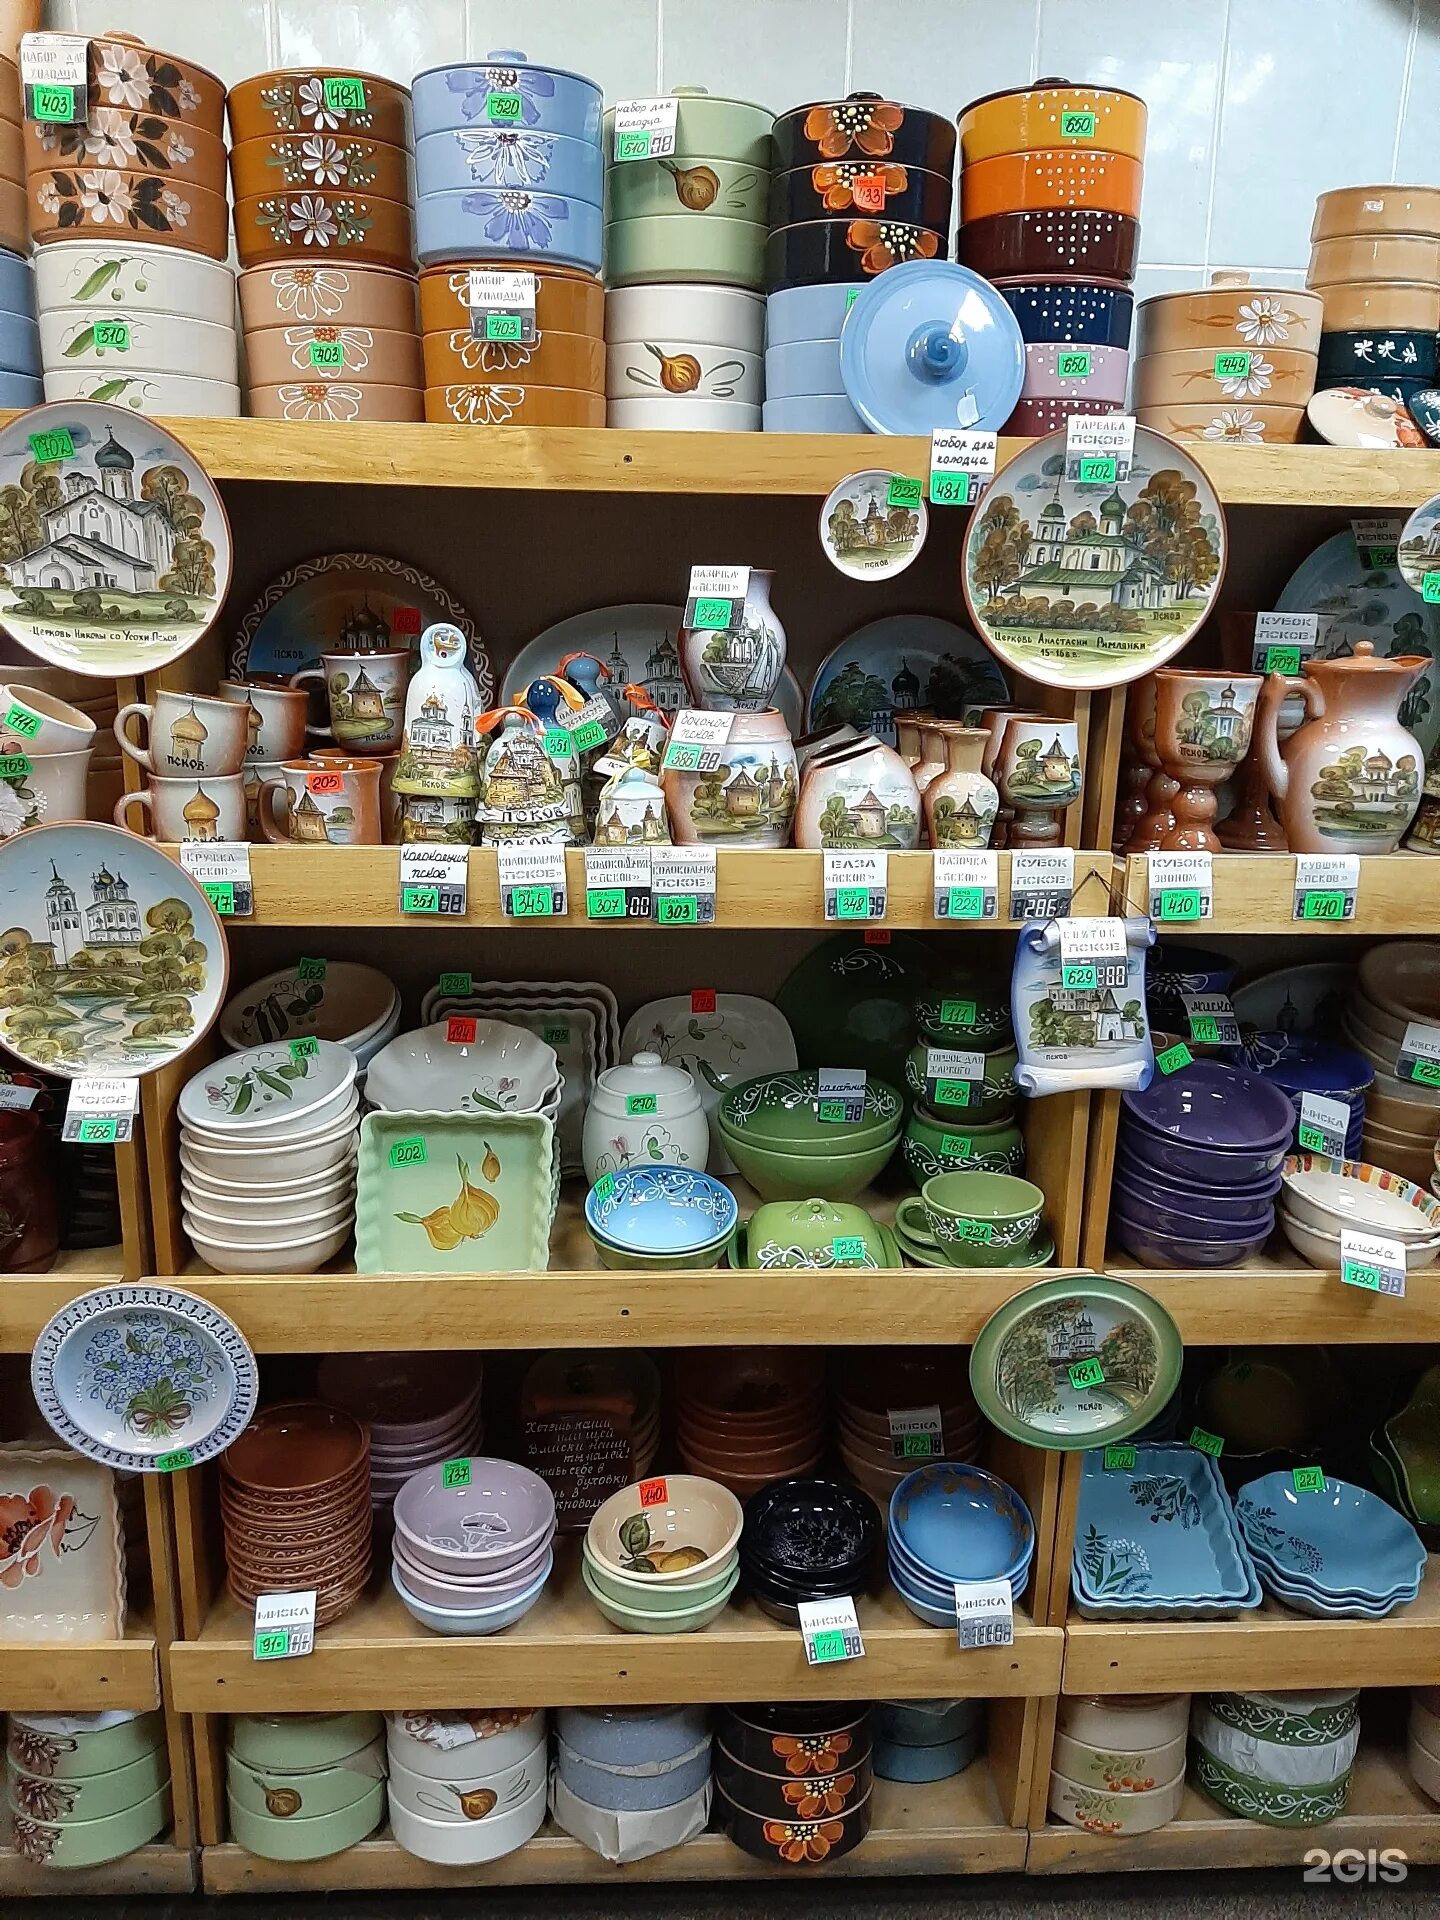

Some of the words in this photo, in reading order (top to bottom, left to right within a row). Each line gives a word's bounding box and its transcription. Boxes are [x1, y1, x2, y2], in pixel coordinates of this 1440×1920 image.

[42, 96, 68, 114] 403
[331, 87, 359, 108] 481
[495, 100, 519, 116] 520
[1065, 116, 1091, 133] 650
[623, 142, 647, 157] 510
[859, 189, 882, 203] 433
[493, 318, 518, 335] 403
[100, 328, 126, 346] 510
[319, 349, 339, 363] 403
[1063, 358, 1087, 372] 650
[1222, 359, 1246, 373] 449
[1075, 420, 1126, 431] ТАРЕЛКА
[934, 436, 968, 451] набор
[971, 440, 995, 453] для
[1085, 464, 1111, 478] 702
[892, 486, 919, 499] 222
[936, 482, 962, 499] 481
[1260, 615, 1313, 627] КУБОК
[550, 737, 567, 754] 351
[578, 730, 600, 747] 494
[312, 775, 339, 790] 205
[501, 806, 565, 823] ПСКОВ
[186, 853, 235, 863] КРУЖКА
[831, 859, 877, 869] ВАЗА
[938, 856, 987, 866] ВАЗОЧКА
[1016, 859, 1069, 869] КУБОК
[1151, 859, 1203, 869] КУБОК
[1300, 861, 1346, 871] КУВШИН
[411, 896, 434, 908] 351
[516, 893, 546, 914] 345
[594, 898, 620, 913] 307
[842, 896, 865, 913] 348
[953, 896, 978, 912] 228
[1167, 898, 1194, 915] 410
[1311, 899, 1338, 917] 410
[665, 904, 690, 919] 303
[1067, 970, 1094, 986] 629
[1191, 1001, 1234, 1014] миска
[1193, 1023, 1217, 1038] 117
[86, 1125, 114, 1140] 766
[397, 1145, 422, 1162] 202
[946, 1138, 966, 1154] 169
[965, 1222, 988, 1238] 221
[839, 1240, 862, 1256] 235
[1343, 1246, 1397, 1261] миска
[1074, 1361, 1099, 1382] 481
[891, 1421, 939, 1432] МИСКА
[644, 1489, 662, 1502] 140
[957, 1599, 1007, 1611] МИСКА
[257, 1607, 310, 1620] МИСКА
[820, 1640, 838, 1654] 111
